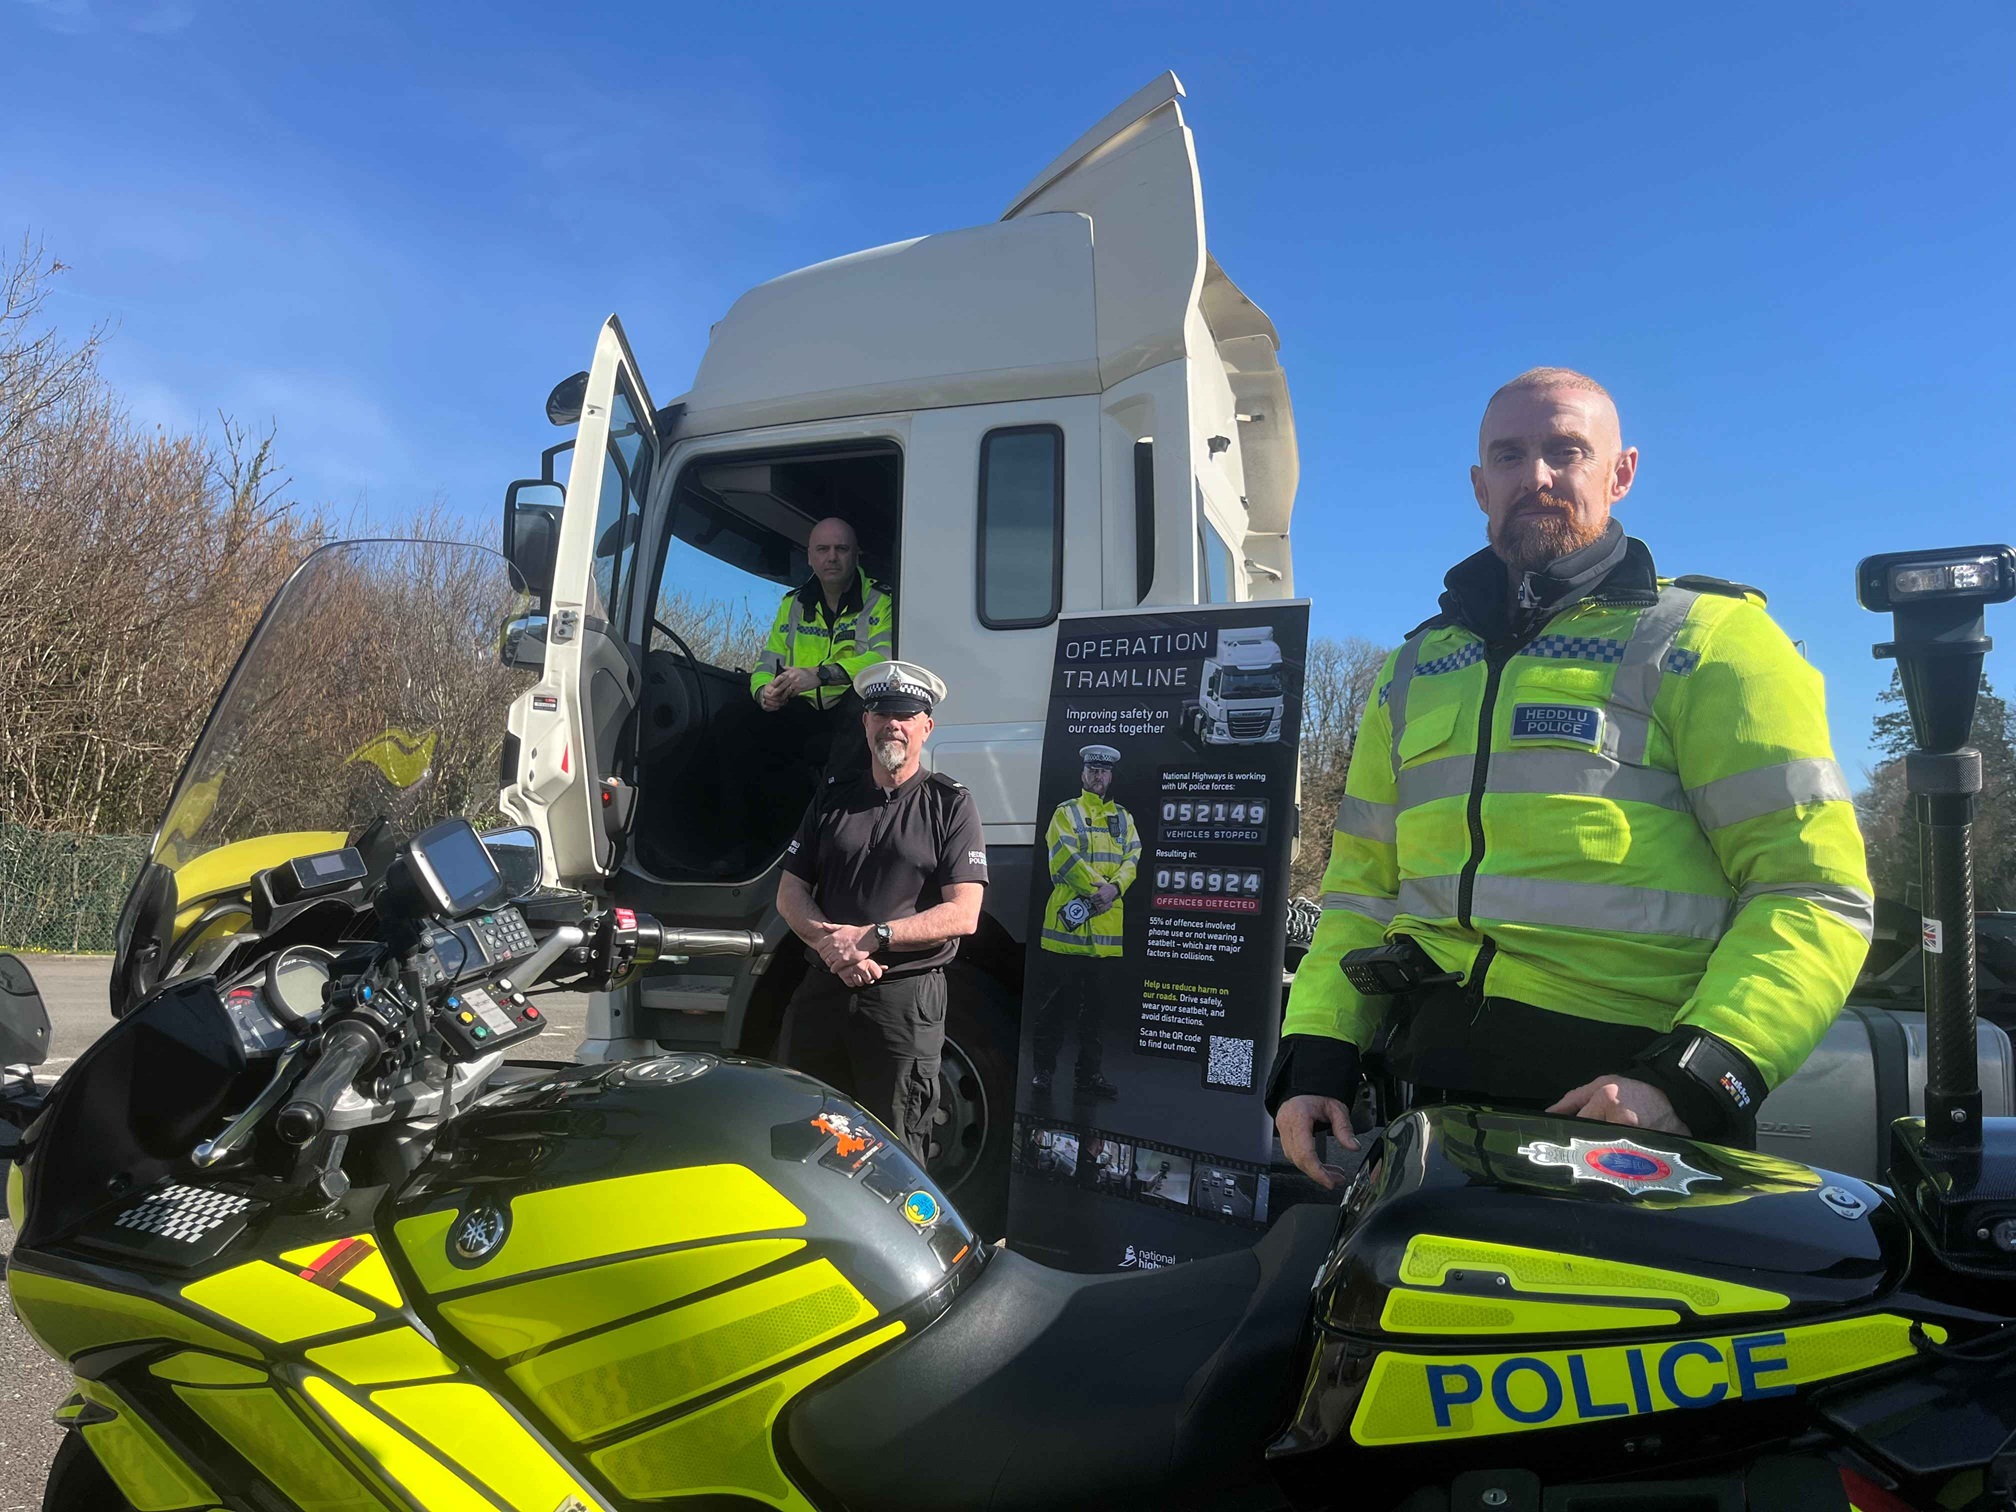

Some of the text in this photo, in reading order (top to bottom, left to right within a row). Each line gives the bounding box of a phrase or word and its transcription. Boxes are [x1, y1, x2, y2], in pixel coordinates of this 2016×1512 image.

[1066, 631, 1207, 659] OPERATION
[1063, 667, 1188, 688] TRAMLINE
[1066, 708, 1169, 721] Improving safety on
[1526, 709, 1588, 722] HEDDLU
[1068, 723, 1165, 736] our roads together
[1527, 722, 1582, 734] POLICE
[1162, 772, 1266, 782] National Highways is working
[1188, 782, 1210, 791] police
[1211, 782, 1235, 790] forces:
[1163, 804, 1264, 824] 052149
[1214, 831, 1258, 839] STOPPED
[1156, 849, 1197, 859] Resulting in:
[1157, 871, 1259, 892] 056924
[1157, 898, 1255, 909] OFFENCES DETECTED
[1150, 917, 1164, 925] 55%
[1174, 919, 1204, 928] offences
[1205, 920, 1236, 930] involved
[1148, 928, 1169, 937] phone
[1207, 933, 1237, 943] wearing
[1148, 939, 1175, 947] seatbelt
[1182, 941, 1203, 949] which
[1218, 944, 1241, 954] major
[1147, 948, 1214, 961] factors in collisions.
[1144, 980, 1160, 990] Help
[1172, 983, 1196, 992] reduce
[1198, 985, 1217, 994] harm
[1156, 993, 1178, 1001] roads.
[1180, 994, 1198, 1003] Drive
[1200, 997, 1222, 1007] safely,
[1142, 1002, 1225, 1017] wear your seatbelt, and
[1161, 1014, 1204, 1026] distractions.
[1140, 1028, 1201, 1042] Scan the QR code
[1148, 1039, 1162, 1048] find
[1176, 1045, 1197, 1053] more.
[1139, 1250, 1176, 1264] national
[1138, 1258, 1164, 1270] high
[1425, 1332, 1797, 1427] POLICE
